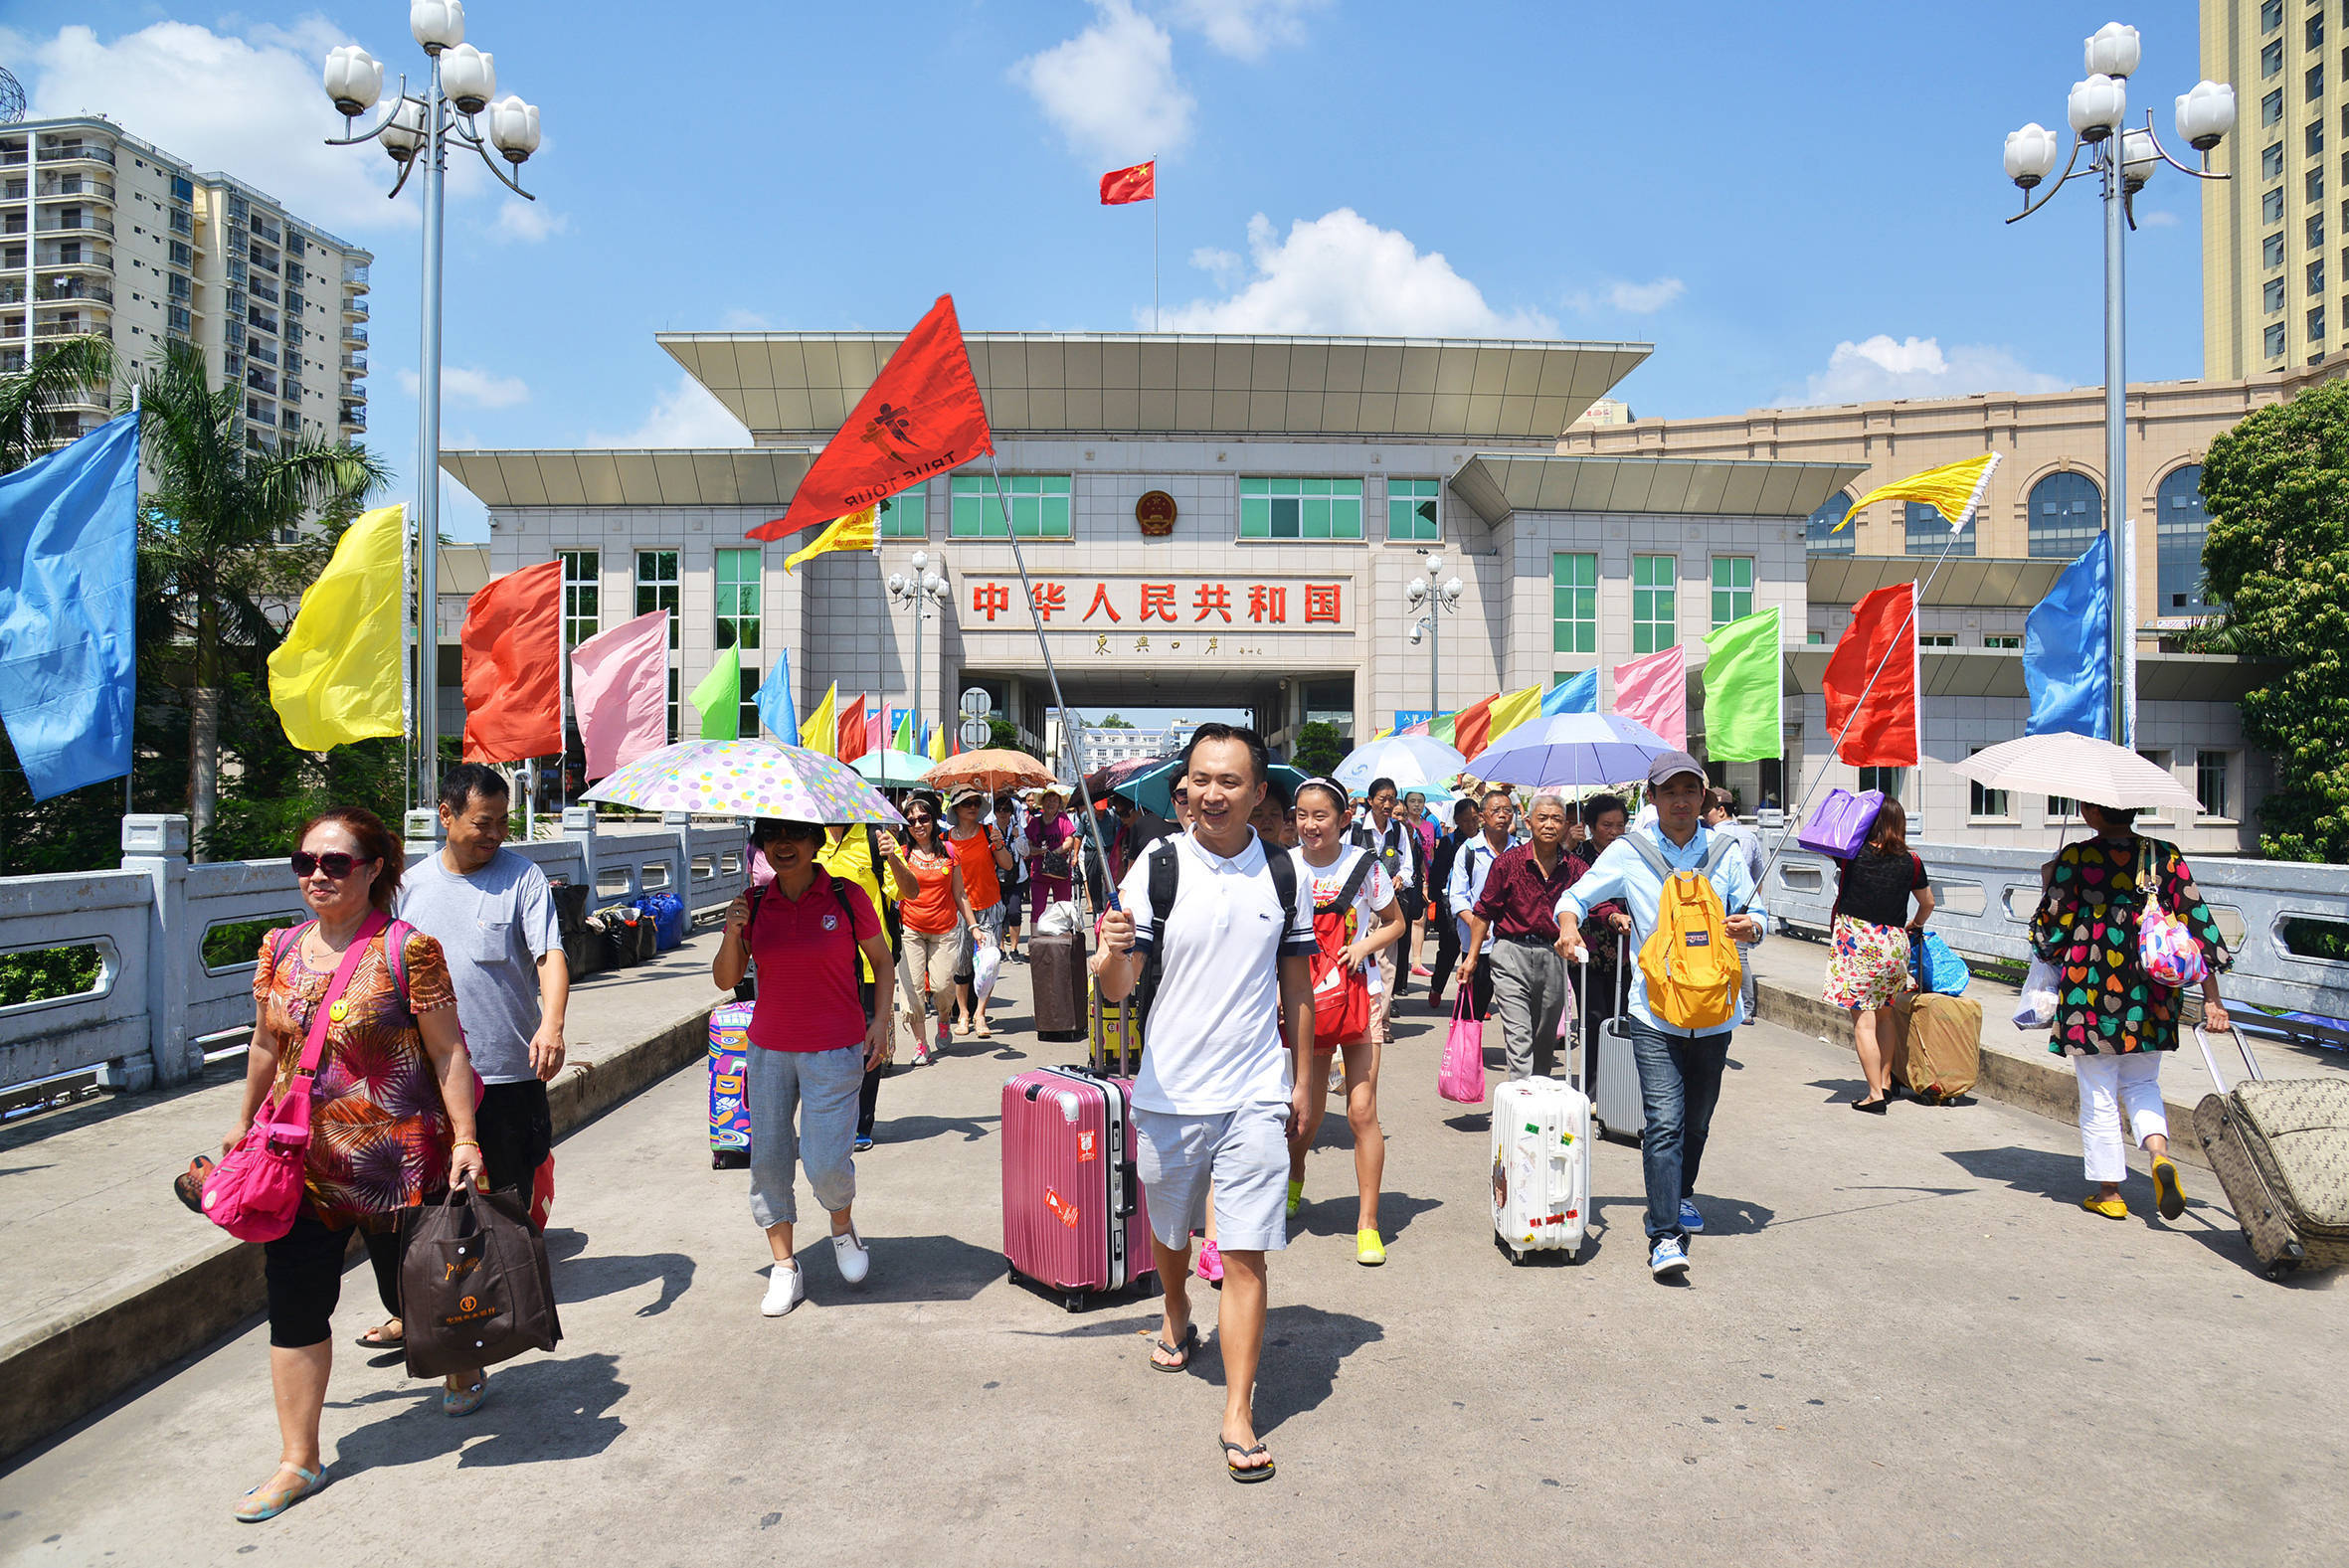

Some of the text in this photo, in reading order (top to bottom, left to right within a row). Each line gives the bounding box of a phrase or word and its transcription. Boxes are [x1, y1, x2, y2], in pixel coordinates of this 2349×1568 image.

[973, 582, 1342, 623] 中华人民共和国
